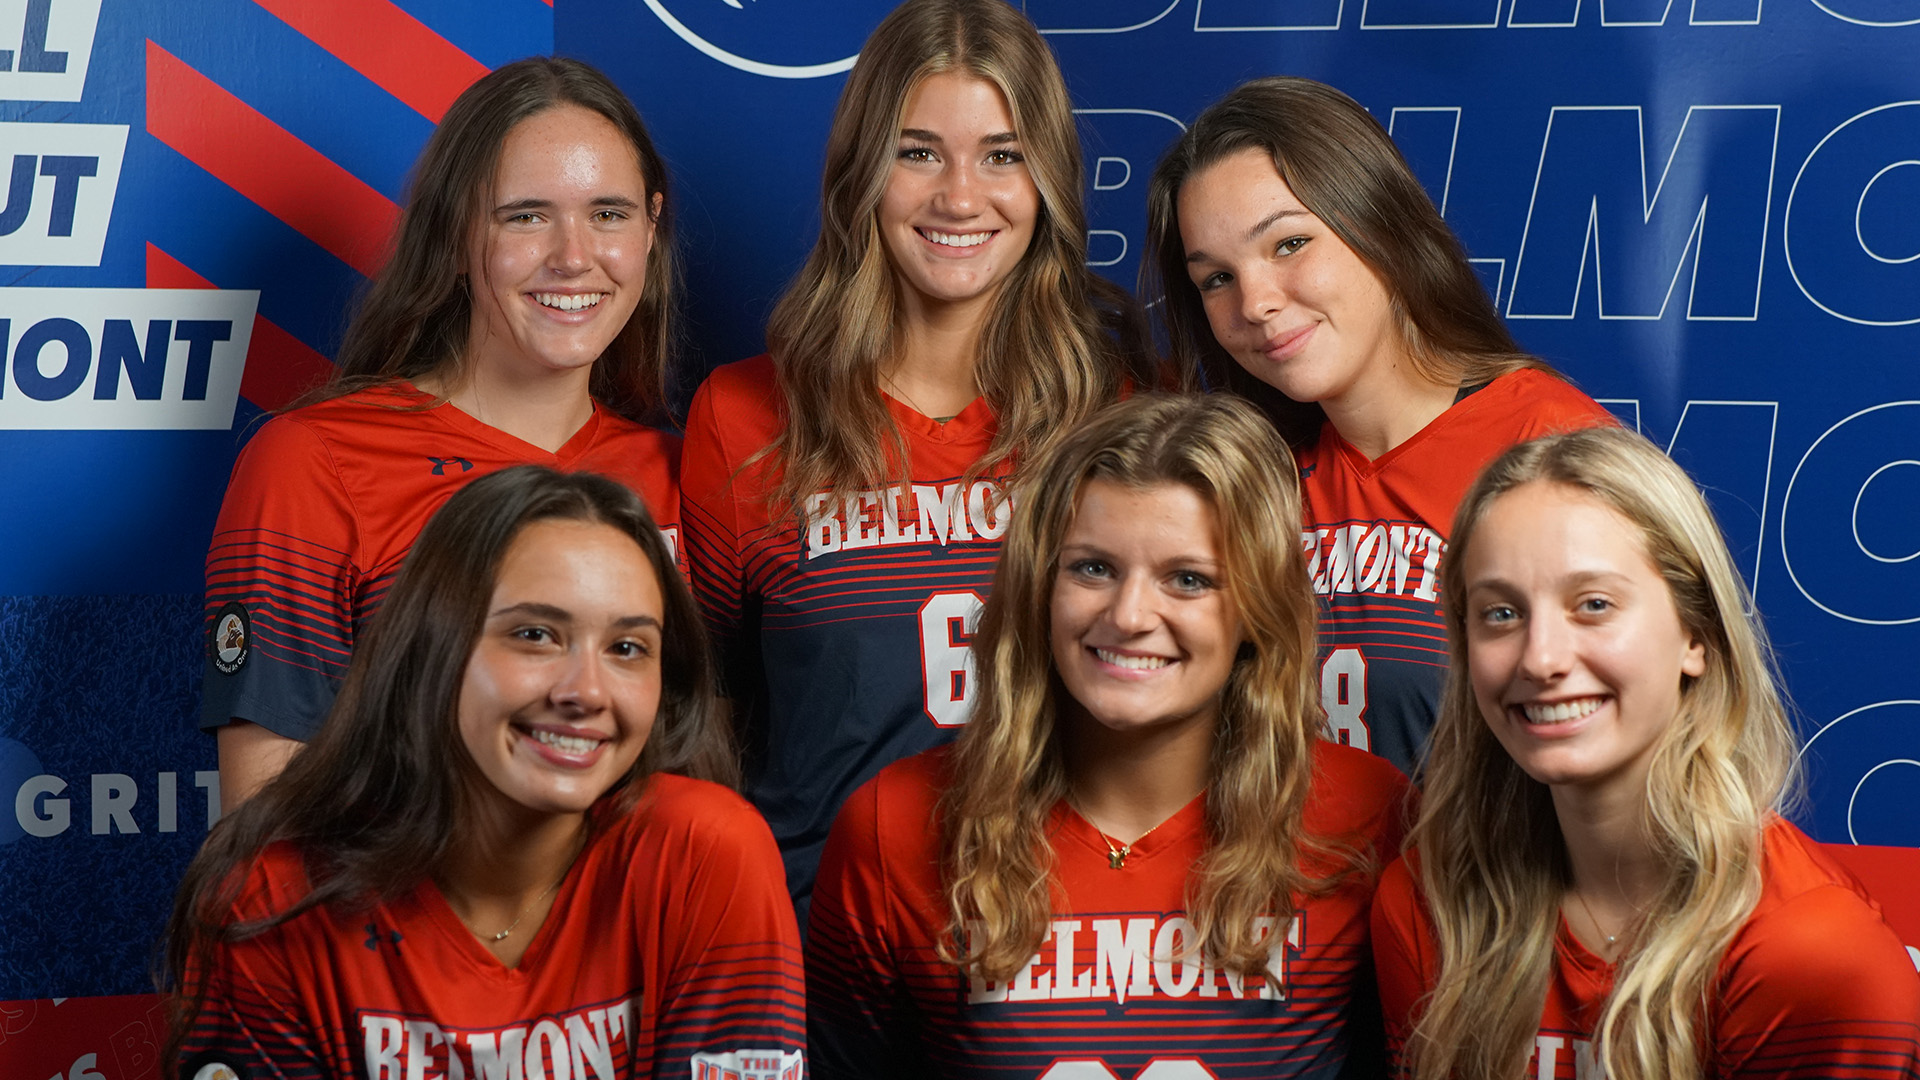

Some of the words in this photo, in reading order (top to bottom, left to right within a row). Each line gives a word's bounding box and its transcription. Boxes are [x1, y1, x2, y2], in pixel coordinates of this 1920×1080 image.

[0, 0, 68, 73] L
[0, 317, 232, 402] ONT
[804, 480, 1016, 560] BELMO
[917, 588, 988, 729] 6
[14, 770, 222, 838] GRIT
[740, 1057, 782, 1070] THE
